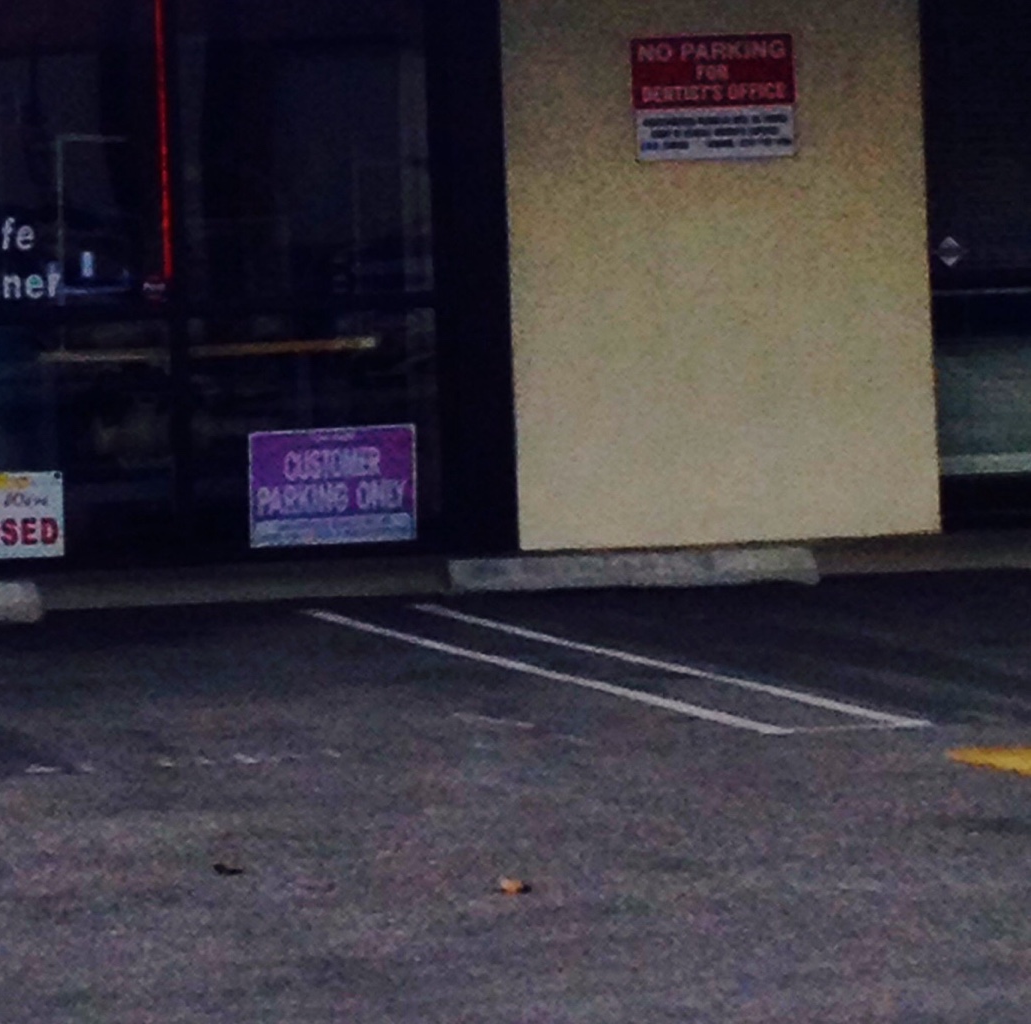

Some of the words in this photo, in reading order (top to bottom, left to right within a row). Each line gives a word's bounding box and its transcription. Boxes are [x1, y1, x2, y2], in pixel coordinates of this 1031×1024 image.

[637, 43, 673, 62] NO
[680, 39, 786, 61] PARKING
[695, 64, 729, 80] FOR
[727, 81, 788, 100] OFFICE
[282, 445, 382, 481] CUSTOMER
[256, 481, 349, 516] PARKING
[355, 479, 408, 511] ONLY
